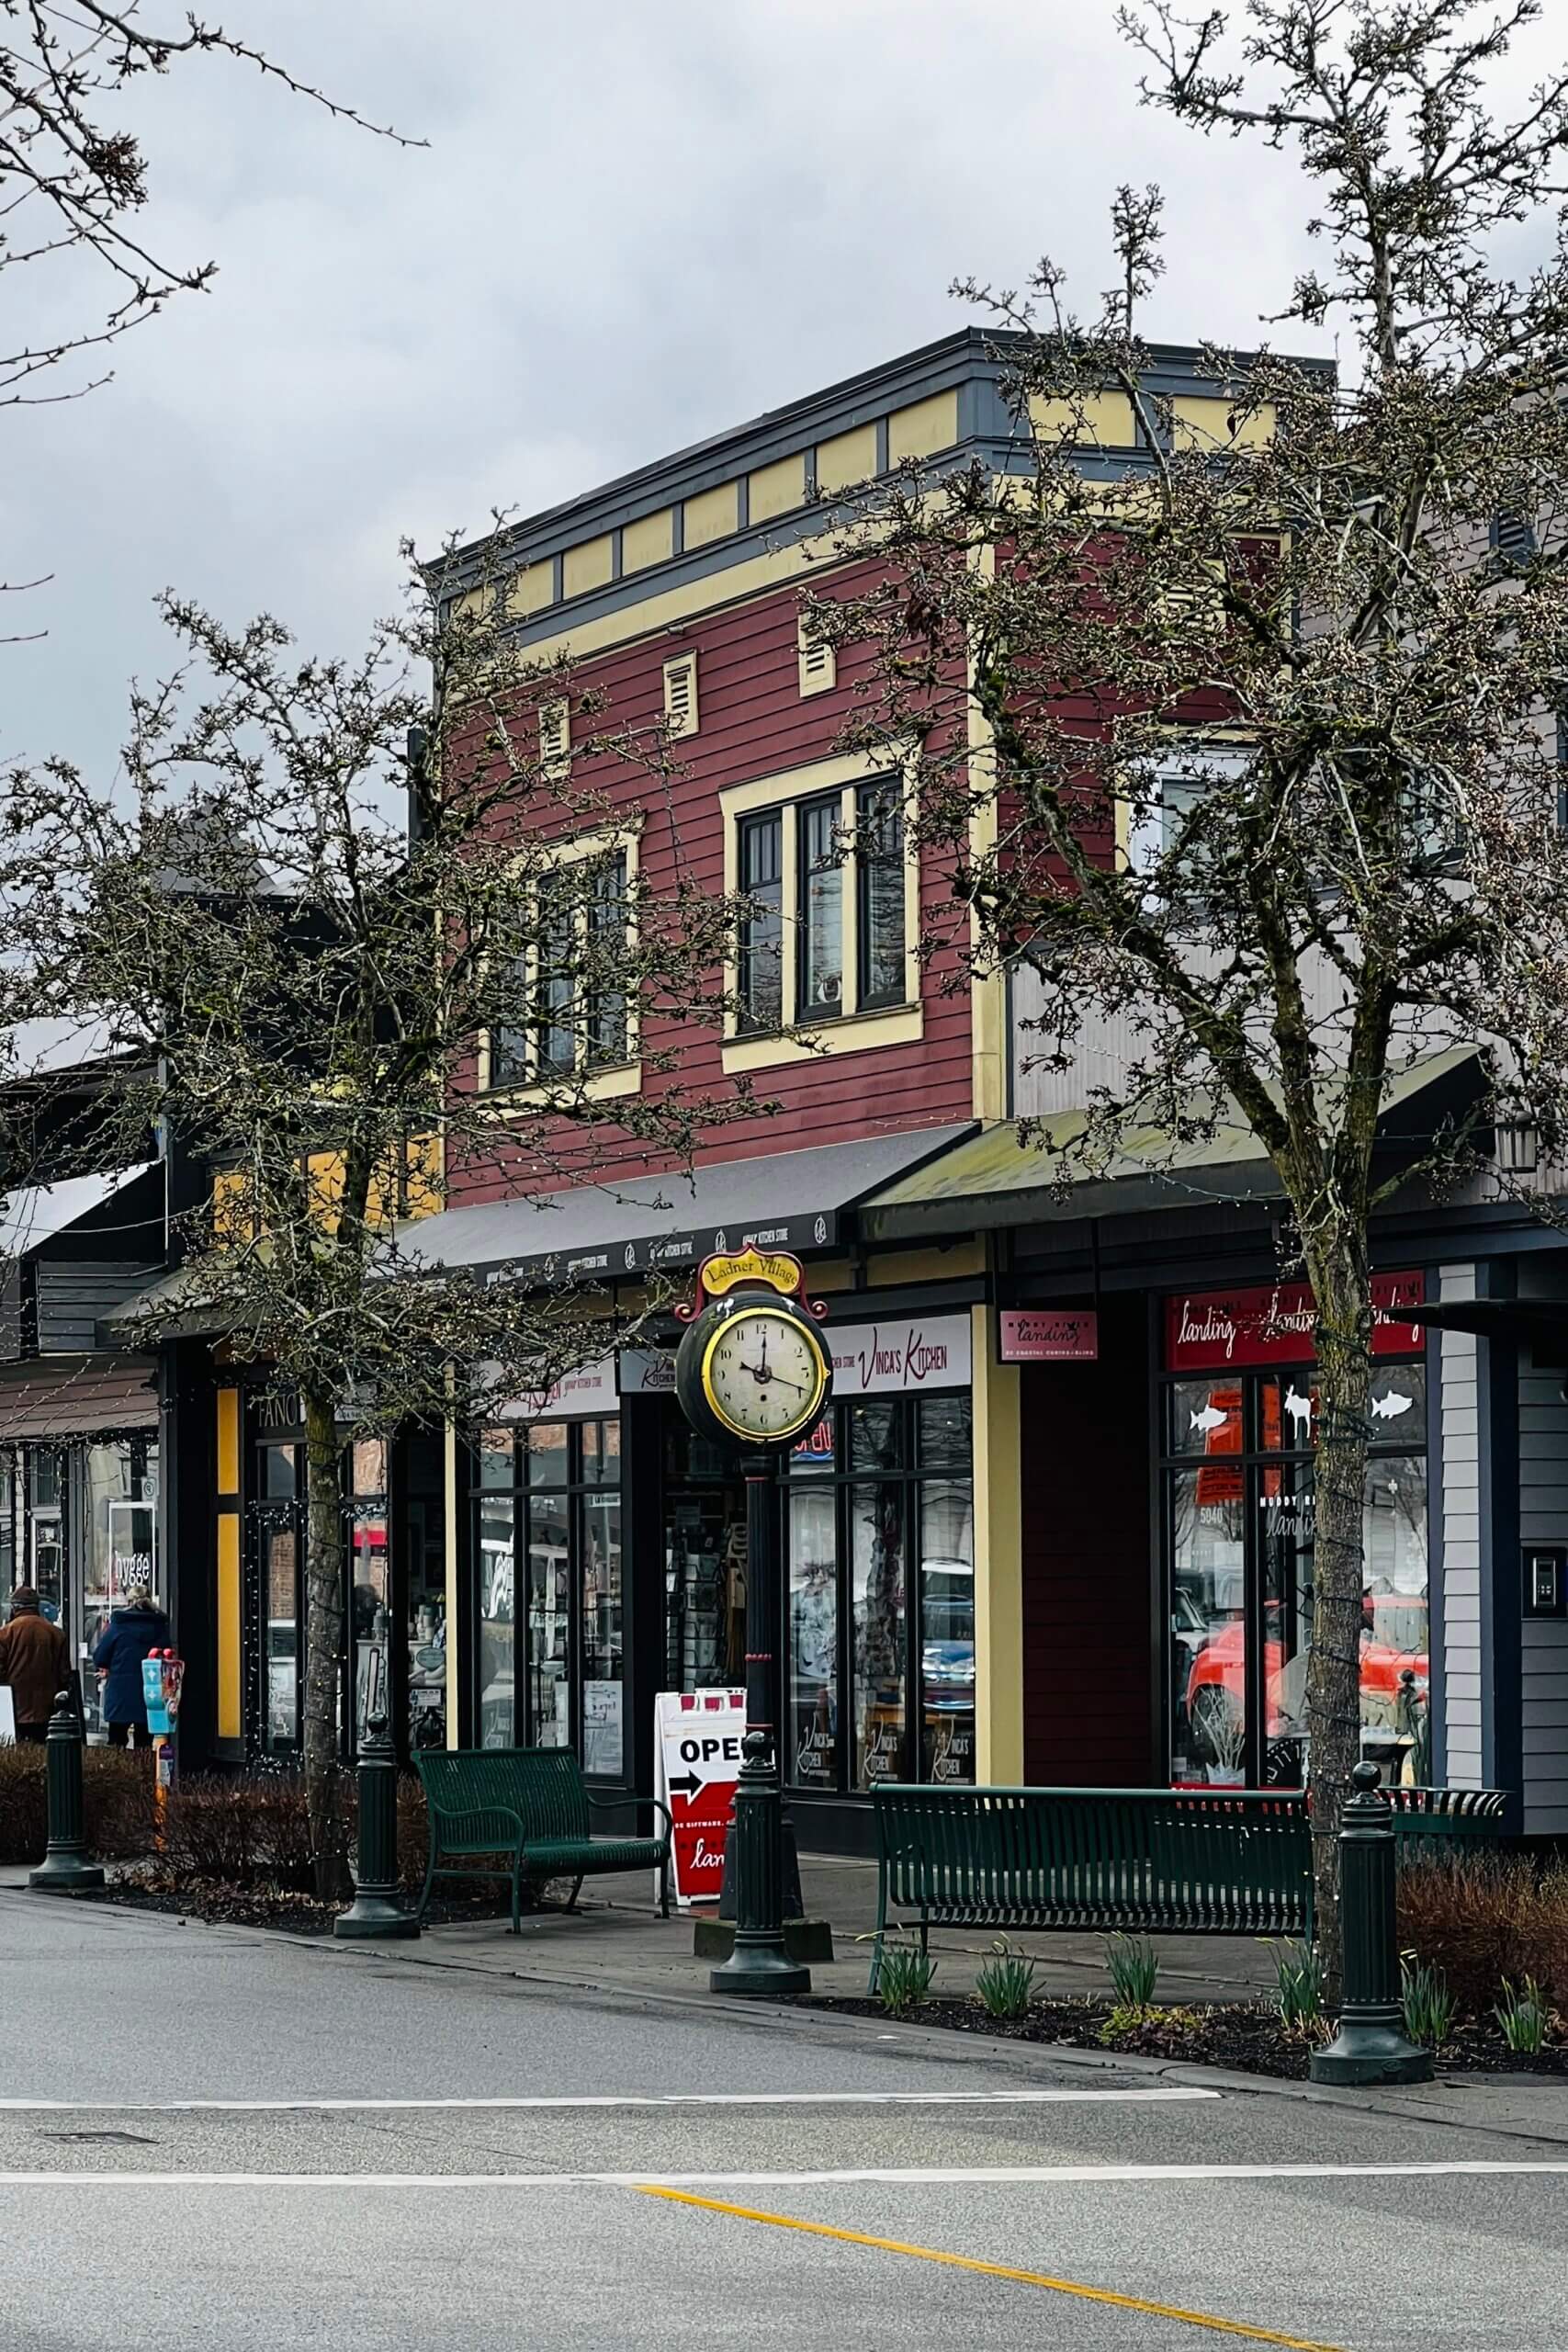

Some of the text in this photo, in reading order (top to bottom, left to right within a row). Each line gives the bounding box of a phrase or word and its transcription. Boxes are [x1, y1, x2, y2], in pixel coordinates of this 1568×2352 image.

[705, 1257, 797, 1284] Ladner Village
[736, 1329, 744, 1341] 11
[756, 1323, 767, 1335] 12
[1018, 1318, 1080, 1348] landing
[1178, 1299, 1236, 1359] landing
[720, 1349, 732, 1361] 10
[795, 1346, 803, 1358] 2
[858, 1326, 901, 1389] VINCA'S
[903, 1329, 947, 1386] KITCHEN
[723, 1391, 731, 1401] 8
[258, 1393, 296, 1427] FANC
[1259, 1496, 1297, 1508] MUDDY
[115, 1550, 150, 1587] hygge
[680, 1737, 745, 1763] OPE
